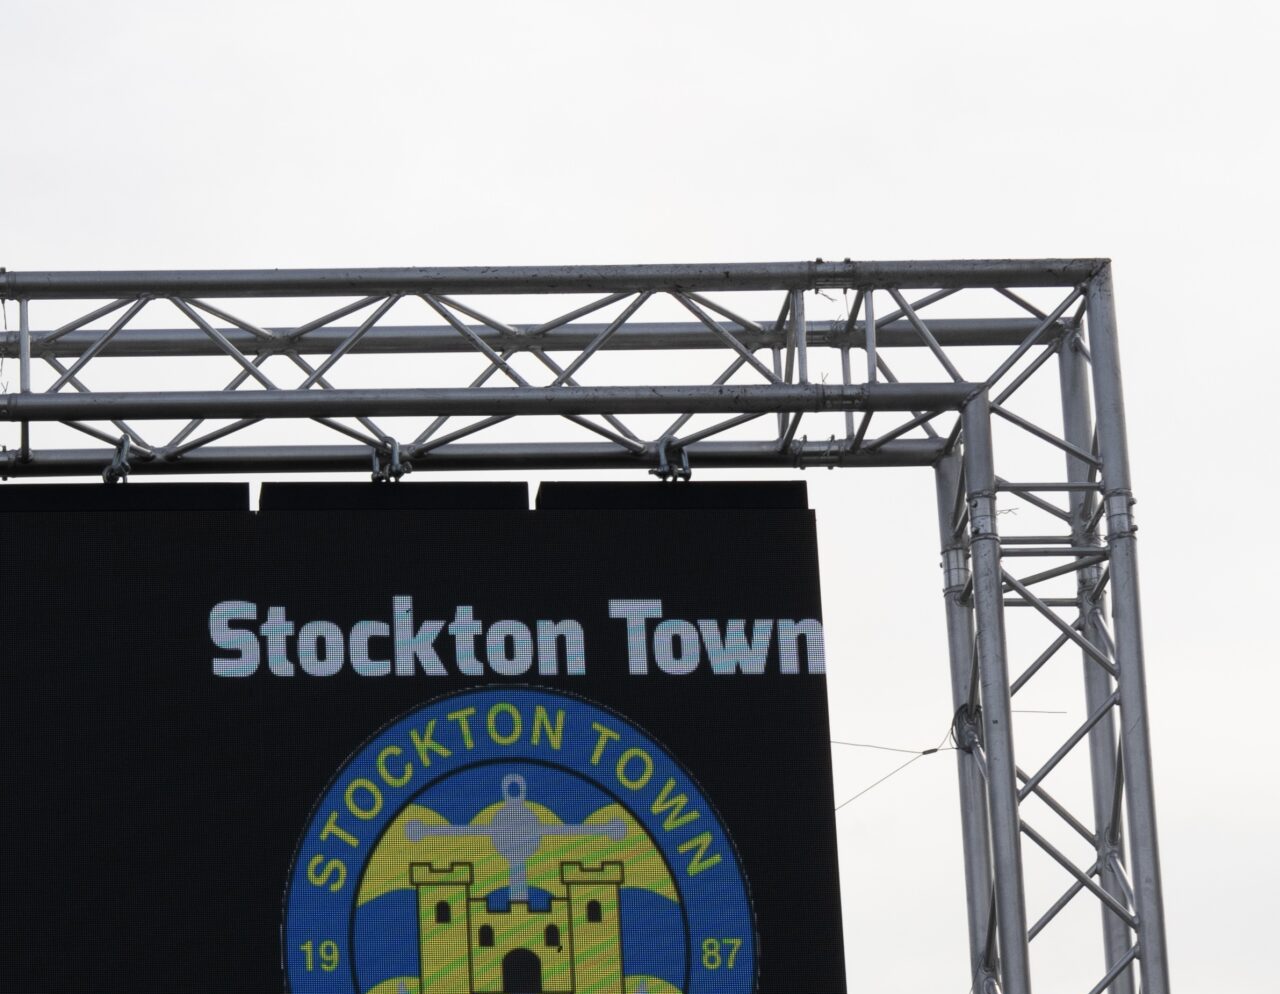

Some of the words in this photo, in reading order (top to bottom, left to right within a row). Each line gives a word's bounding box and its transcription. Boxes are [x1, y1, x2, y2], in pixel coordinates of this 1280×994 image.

[208, 595, 586, 677] Stockton
[609, 599, 826, 675] Town
[307, 702, 565, 892] STOCKTON
[590, 722, 721, 877] TOWN
[300, 940, 340, 972] 19
[701, 938, 742, 969] 87
